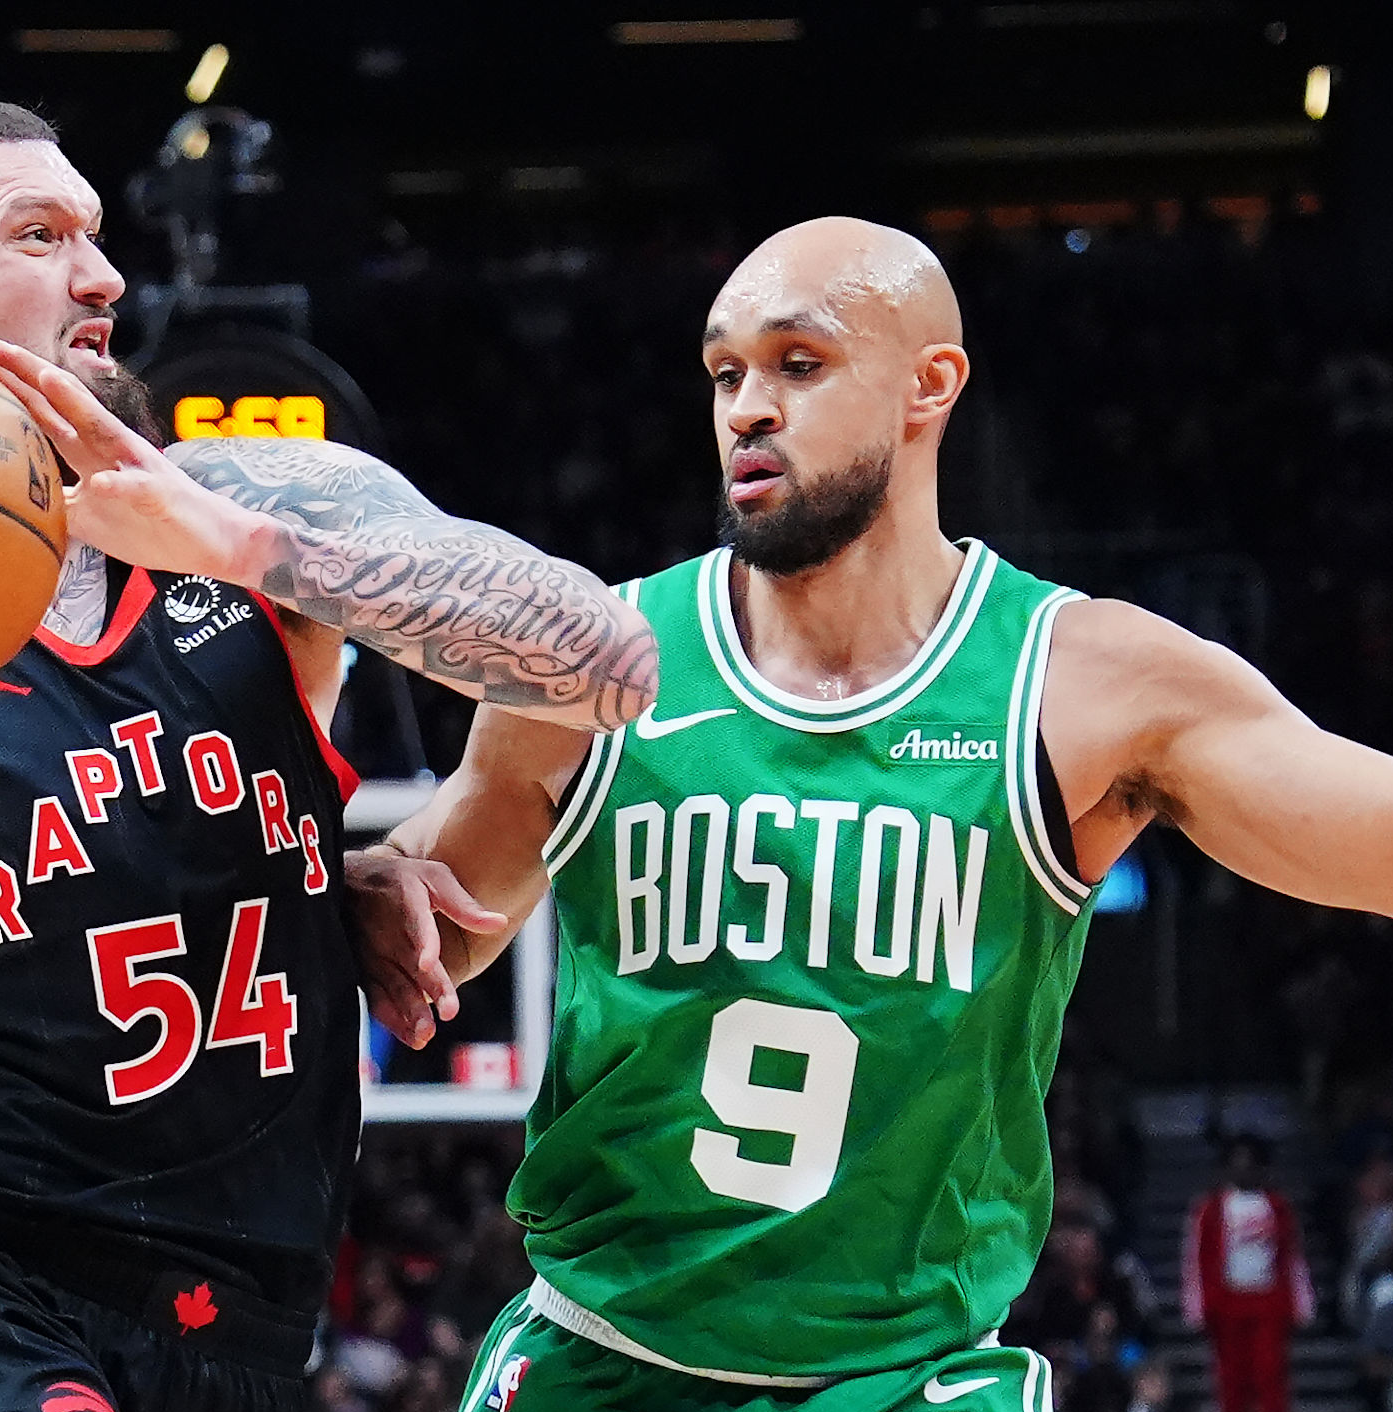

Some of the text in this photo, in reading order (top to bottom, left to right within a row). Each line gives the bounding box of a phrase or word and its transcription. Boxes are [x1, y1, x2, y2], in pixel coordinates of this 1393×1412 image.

[174, 601, 254, 654] Sun Life
[889, 728, 999, 762] Amica
[614, 792, 990, 994] BOSTON
[86, 898, 299, 1106] 54
[689, 997, 860, 1214] 9
